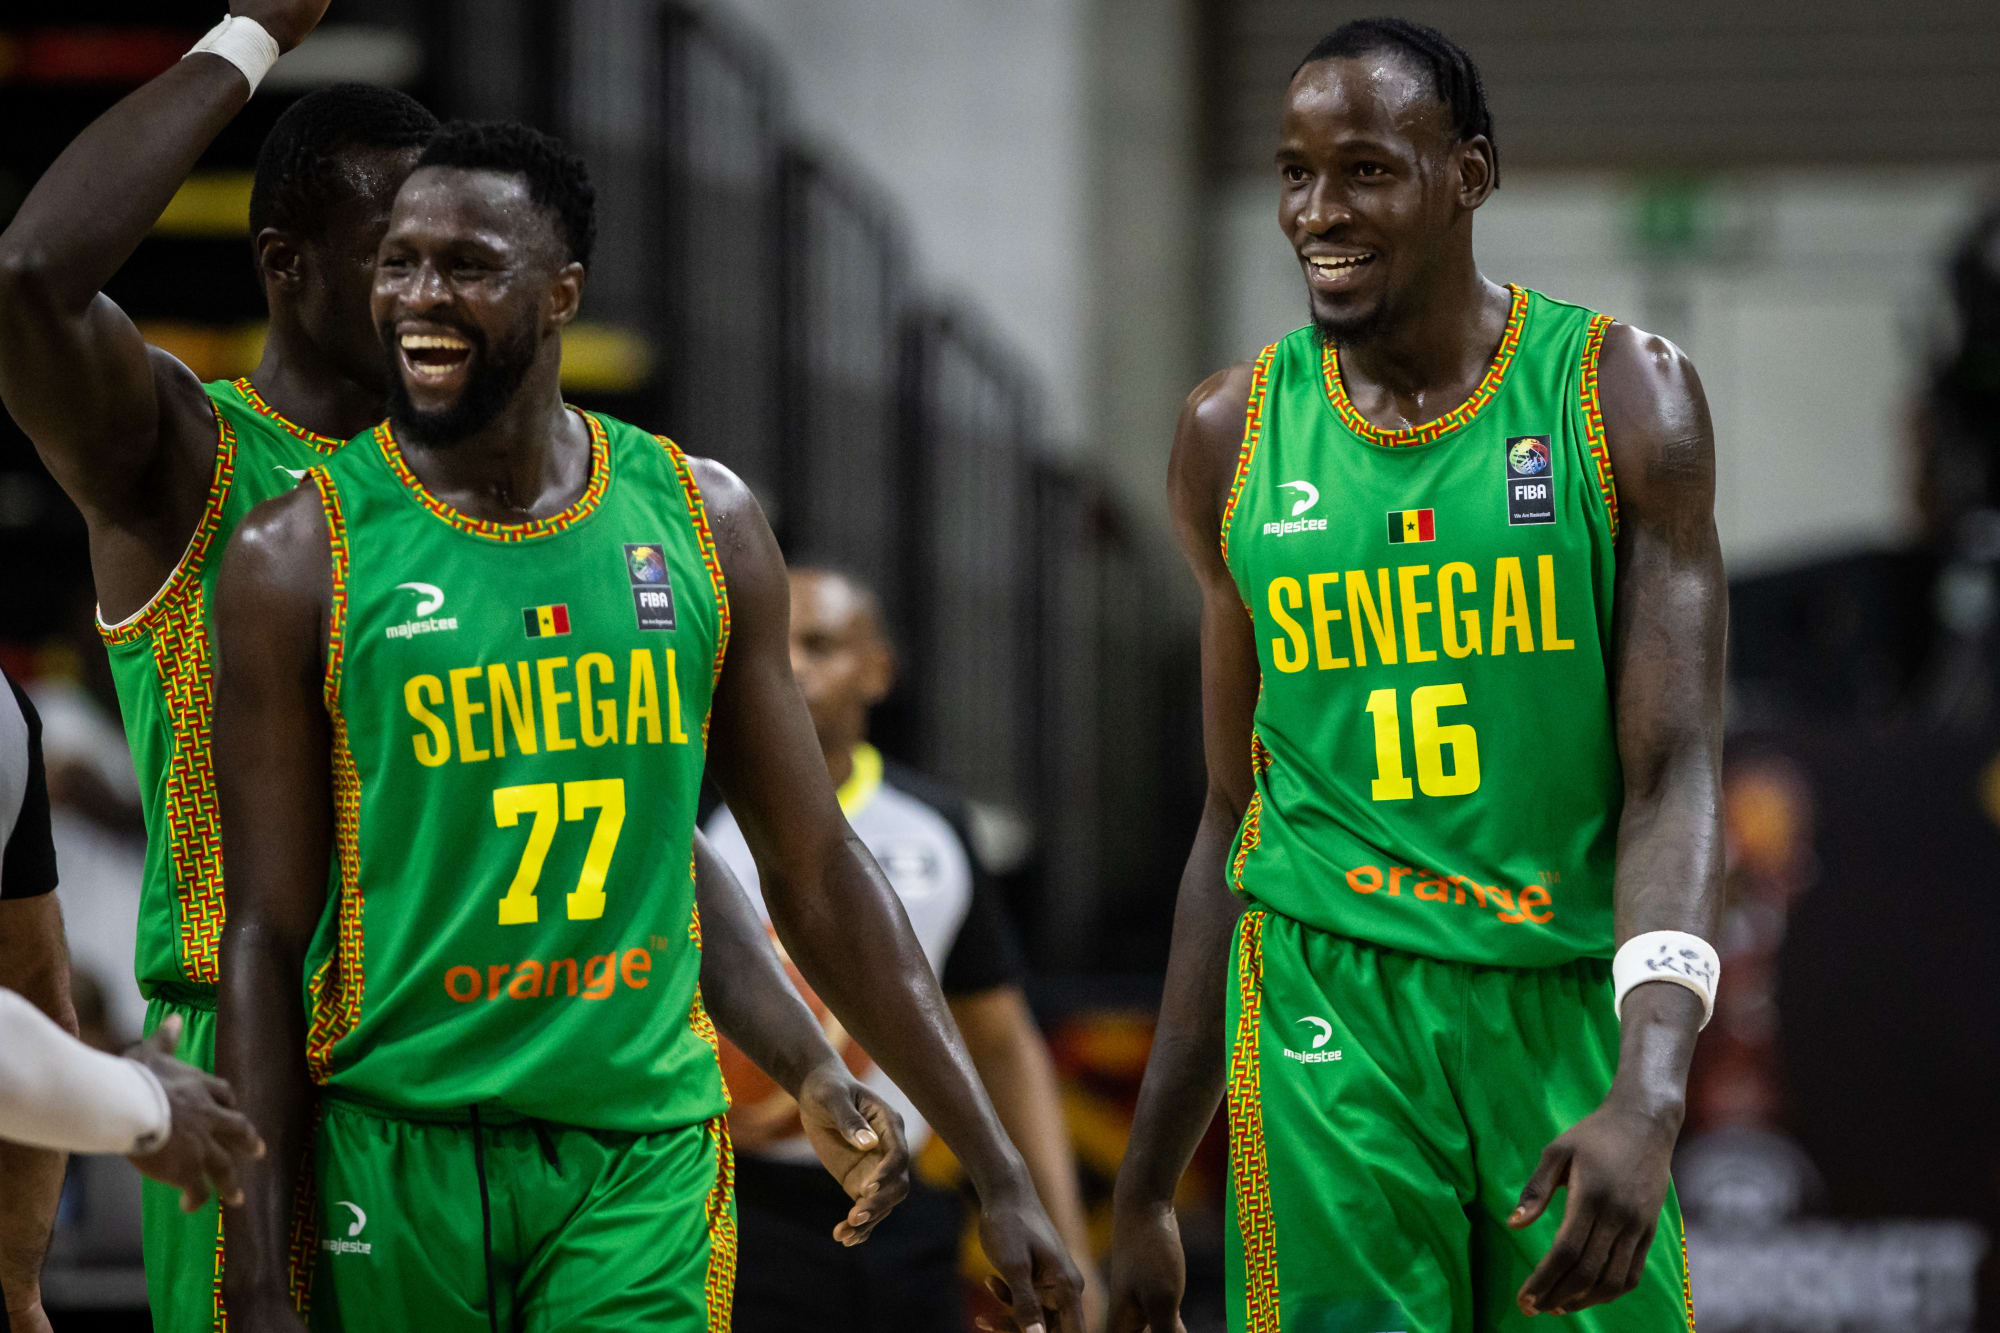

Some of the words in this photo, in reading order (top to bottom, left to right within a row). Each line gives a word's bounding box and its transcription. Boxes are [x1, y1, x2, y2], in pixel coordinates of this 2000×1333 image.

[1514, 483, 1547, 501] FIBA
[1263, 517, 1327, 537] majestee
[386, 617, 458, 639] majestee
[640, 592, 669, 608] FIBA
[1268, 554, 1575, 673] SENEGAL
[404, 648, 688, 767] SENEGAL
[1365, 683, 1481, 801] 16
[493, 778, 626, 925] 77
[1345, 865, 1555, 924] orange
[444, 947, 652, 1003] orange
[1283, 1048, 1342, 1064] majestee
